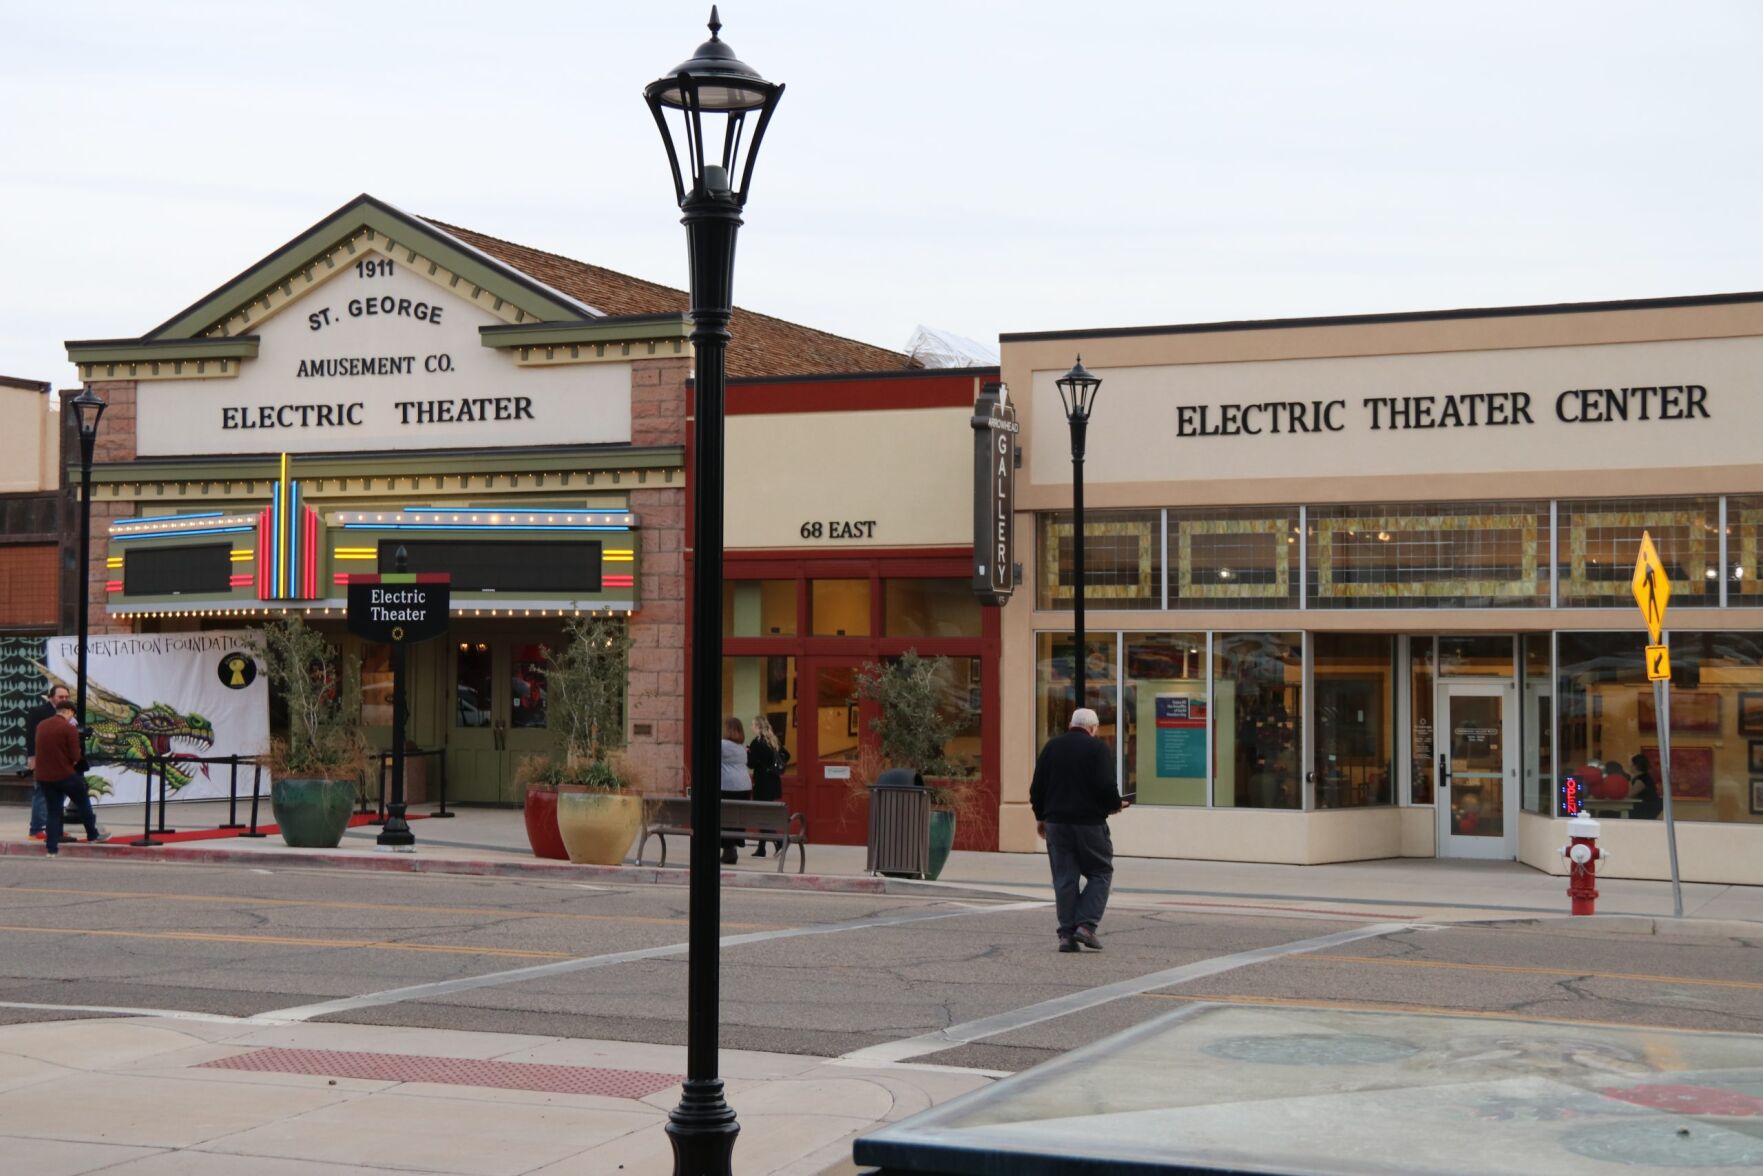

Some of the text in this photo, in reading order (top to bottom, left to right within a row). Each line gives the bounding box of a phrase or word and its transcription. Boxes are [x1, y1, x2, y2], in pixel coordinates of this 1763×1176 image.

[355, 259, 395, 279] 1911
[308, 295, 444, 332] ST. GEORGE
[296, 353, 455, 378] AMUSEMENT CO.
[222, 396, 535, 430] ELECTRIC THEATER
[1175, 384, 1711, 438] ELECTRIC THEATER CENTER
[988, 417, 1019, 433] ARROWHEAD
[997, 435, 1007, 584] GALLERY
[800, 520, 877, 539] 68 EAST
[371, 589, 426, 604] Electric
[370, 606, 426, 621] Theater
[1567, 779, 1577, 814] OPEN
